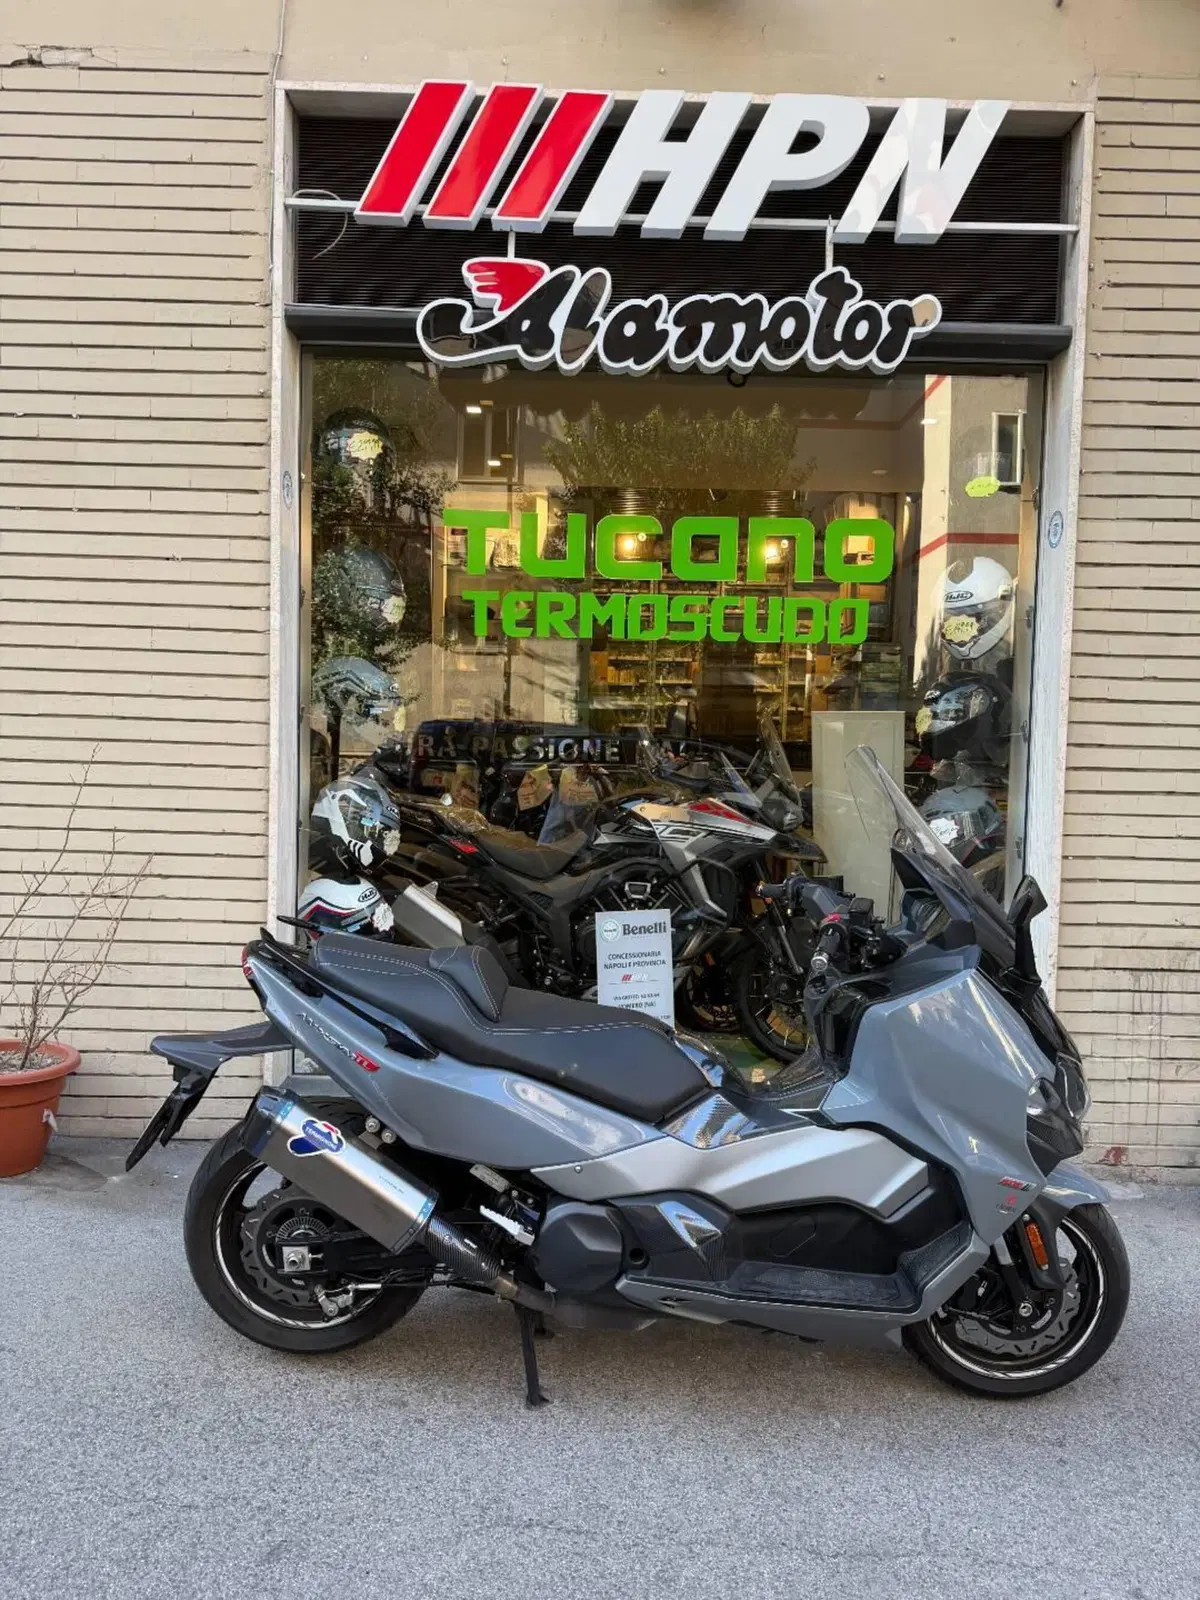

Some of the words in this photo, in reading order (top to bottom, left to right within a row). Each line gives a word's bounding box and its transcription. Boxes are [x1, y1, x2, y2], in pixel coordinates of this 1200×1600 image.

[573, 90, 1011, 243] HPN
[461, 589, 870, 645] TERMOSCUDO
[622, 921, 667, 936] Benelli
[603, 962, 628, 970] NAPOLI
[632, 959, 667, 968] PROVINCIA
